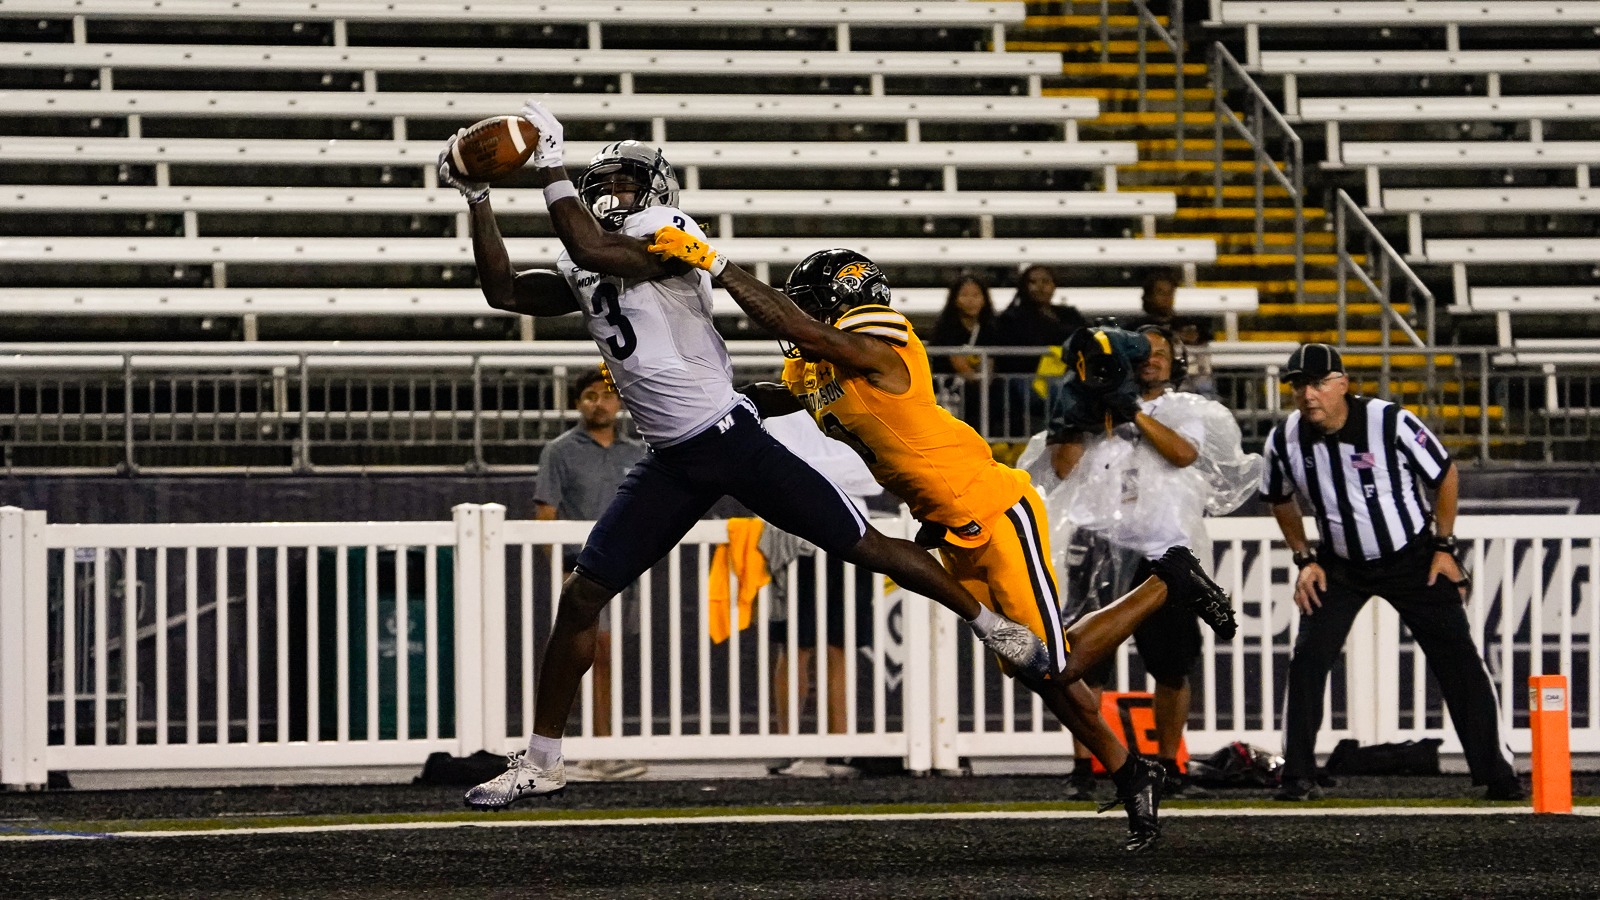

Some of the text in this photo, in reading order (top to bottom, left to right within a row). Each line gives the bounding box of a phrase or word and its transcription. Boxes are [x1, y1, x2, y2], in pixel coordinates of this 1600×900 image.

[591, 282, 638, 361] 3
[714, 412, 736, 435] M
[1305, 456, 1313, 468] S
